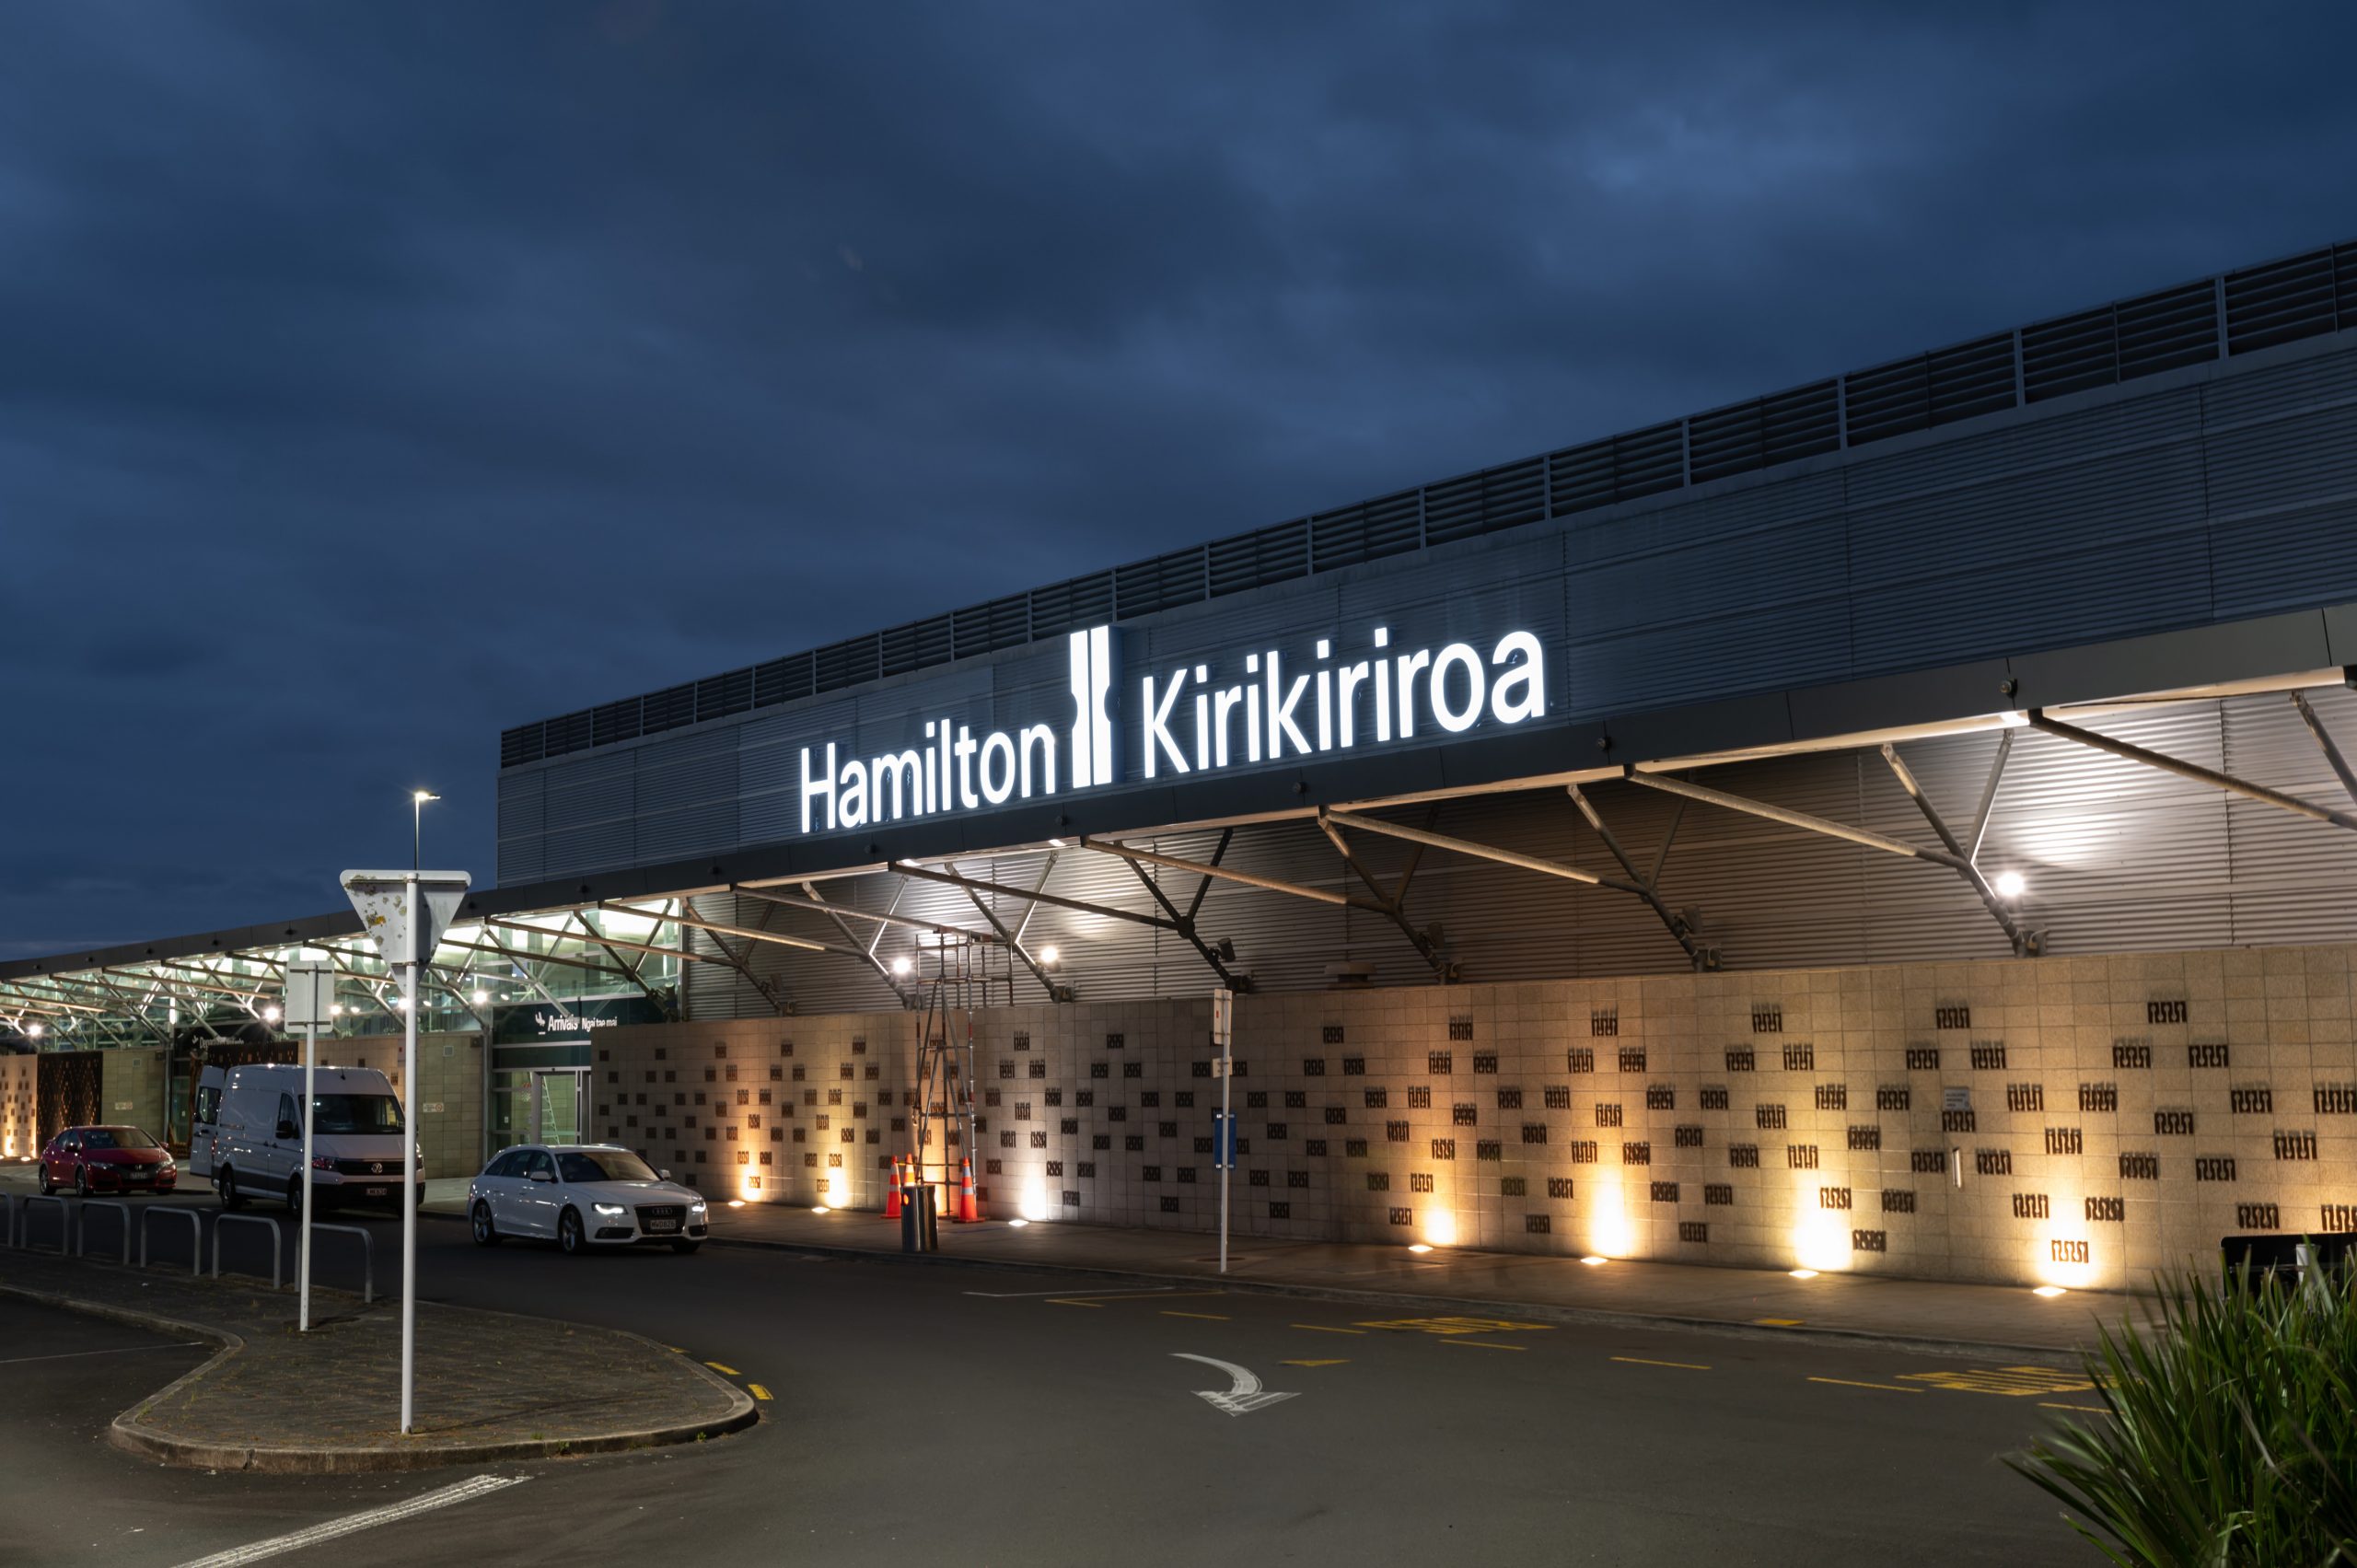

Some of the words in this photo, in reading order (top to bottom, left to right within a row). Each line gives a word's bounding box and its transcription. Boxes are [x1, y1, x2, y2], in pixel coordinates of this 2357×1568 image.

[800, 718, 1056, 834] Hamilton
[1142, 627, 1546, 779] Kirikiriroa
[548, 1014, 578, 1031] Arrivals
